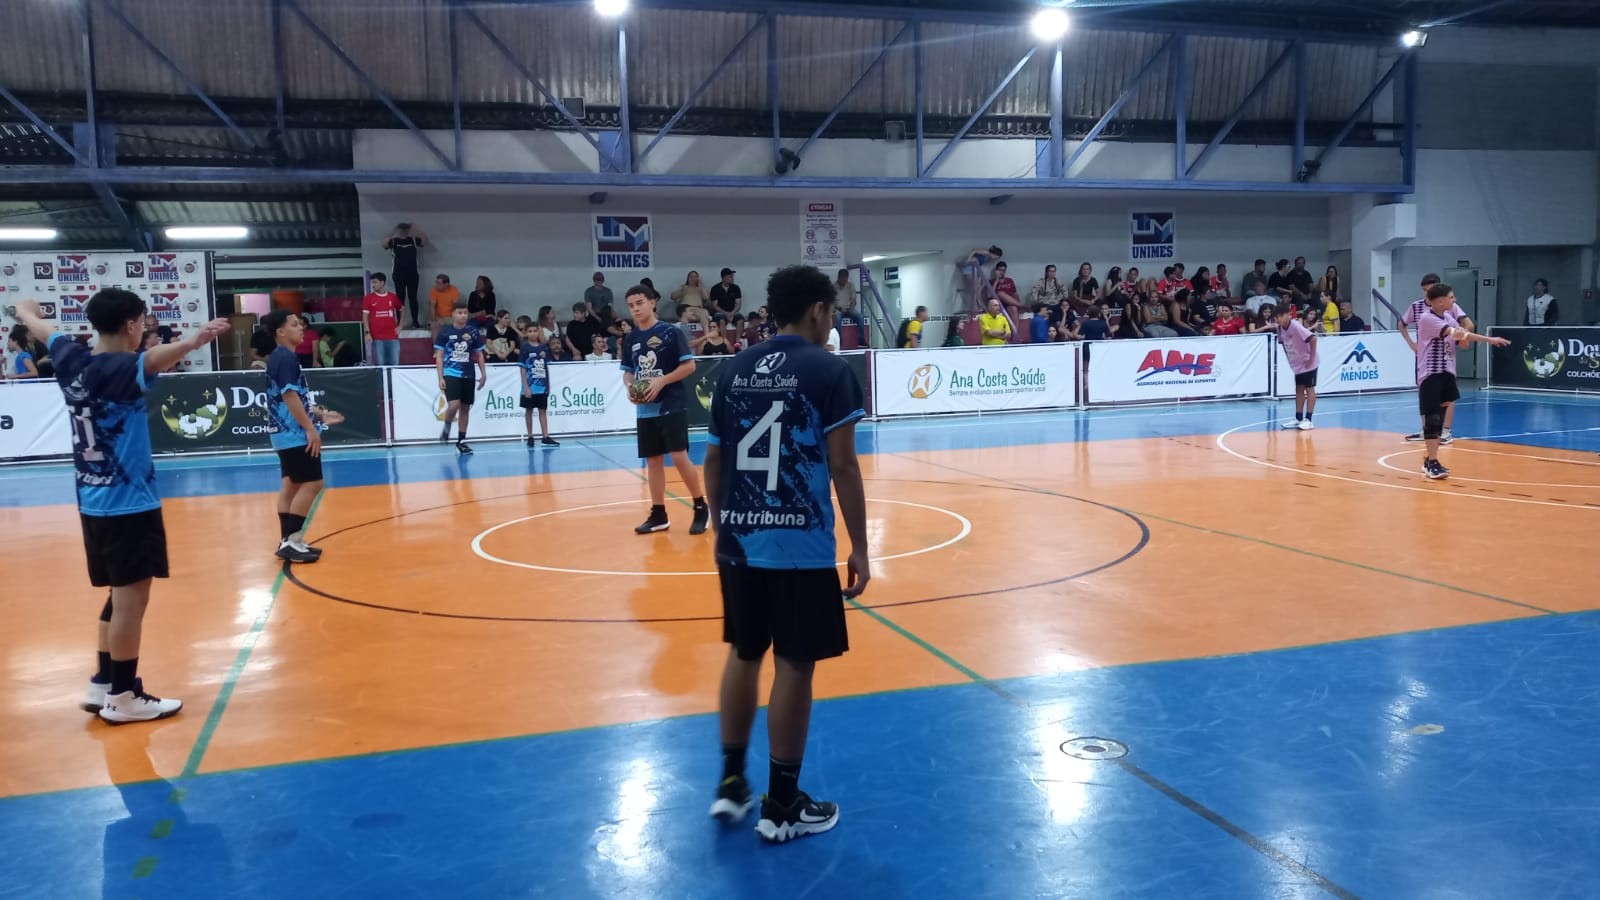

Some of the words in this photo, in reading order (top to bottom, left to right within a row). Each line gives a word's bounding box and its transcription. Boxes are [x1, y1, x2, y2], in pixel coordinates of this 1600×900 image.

[1132, 245, 1174, 259] UNIMES
[597, 253, 650, 269] UNIMES
[57, 273, 90, 282] UNIMES
[148, 271, 179, 281] UNIMES
[1136, 349, 1216, 376] ANE
[732, 374, 748, 388] Ana
[750, 374, 773, 388] Costa
[773, 374, 799, 388] Saúde
[950, 370, 973, 389] Ana
[977, 368, 1008, 388] Costa
[1011, 366, 1046, 386] Saúde
[1341, 370, 1379, 381] MENDES
[485, 389, 514, 411] Ana
[562, 386, 605, 408] Saúde
[248, 408, 261, 417] do
[736, 400, 784, 491] 4
[730, 510, 746, 525] tv
[747, 510, 806, 526] tribuna
